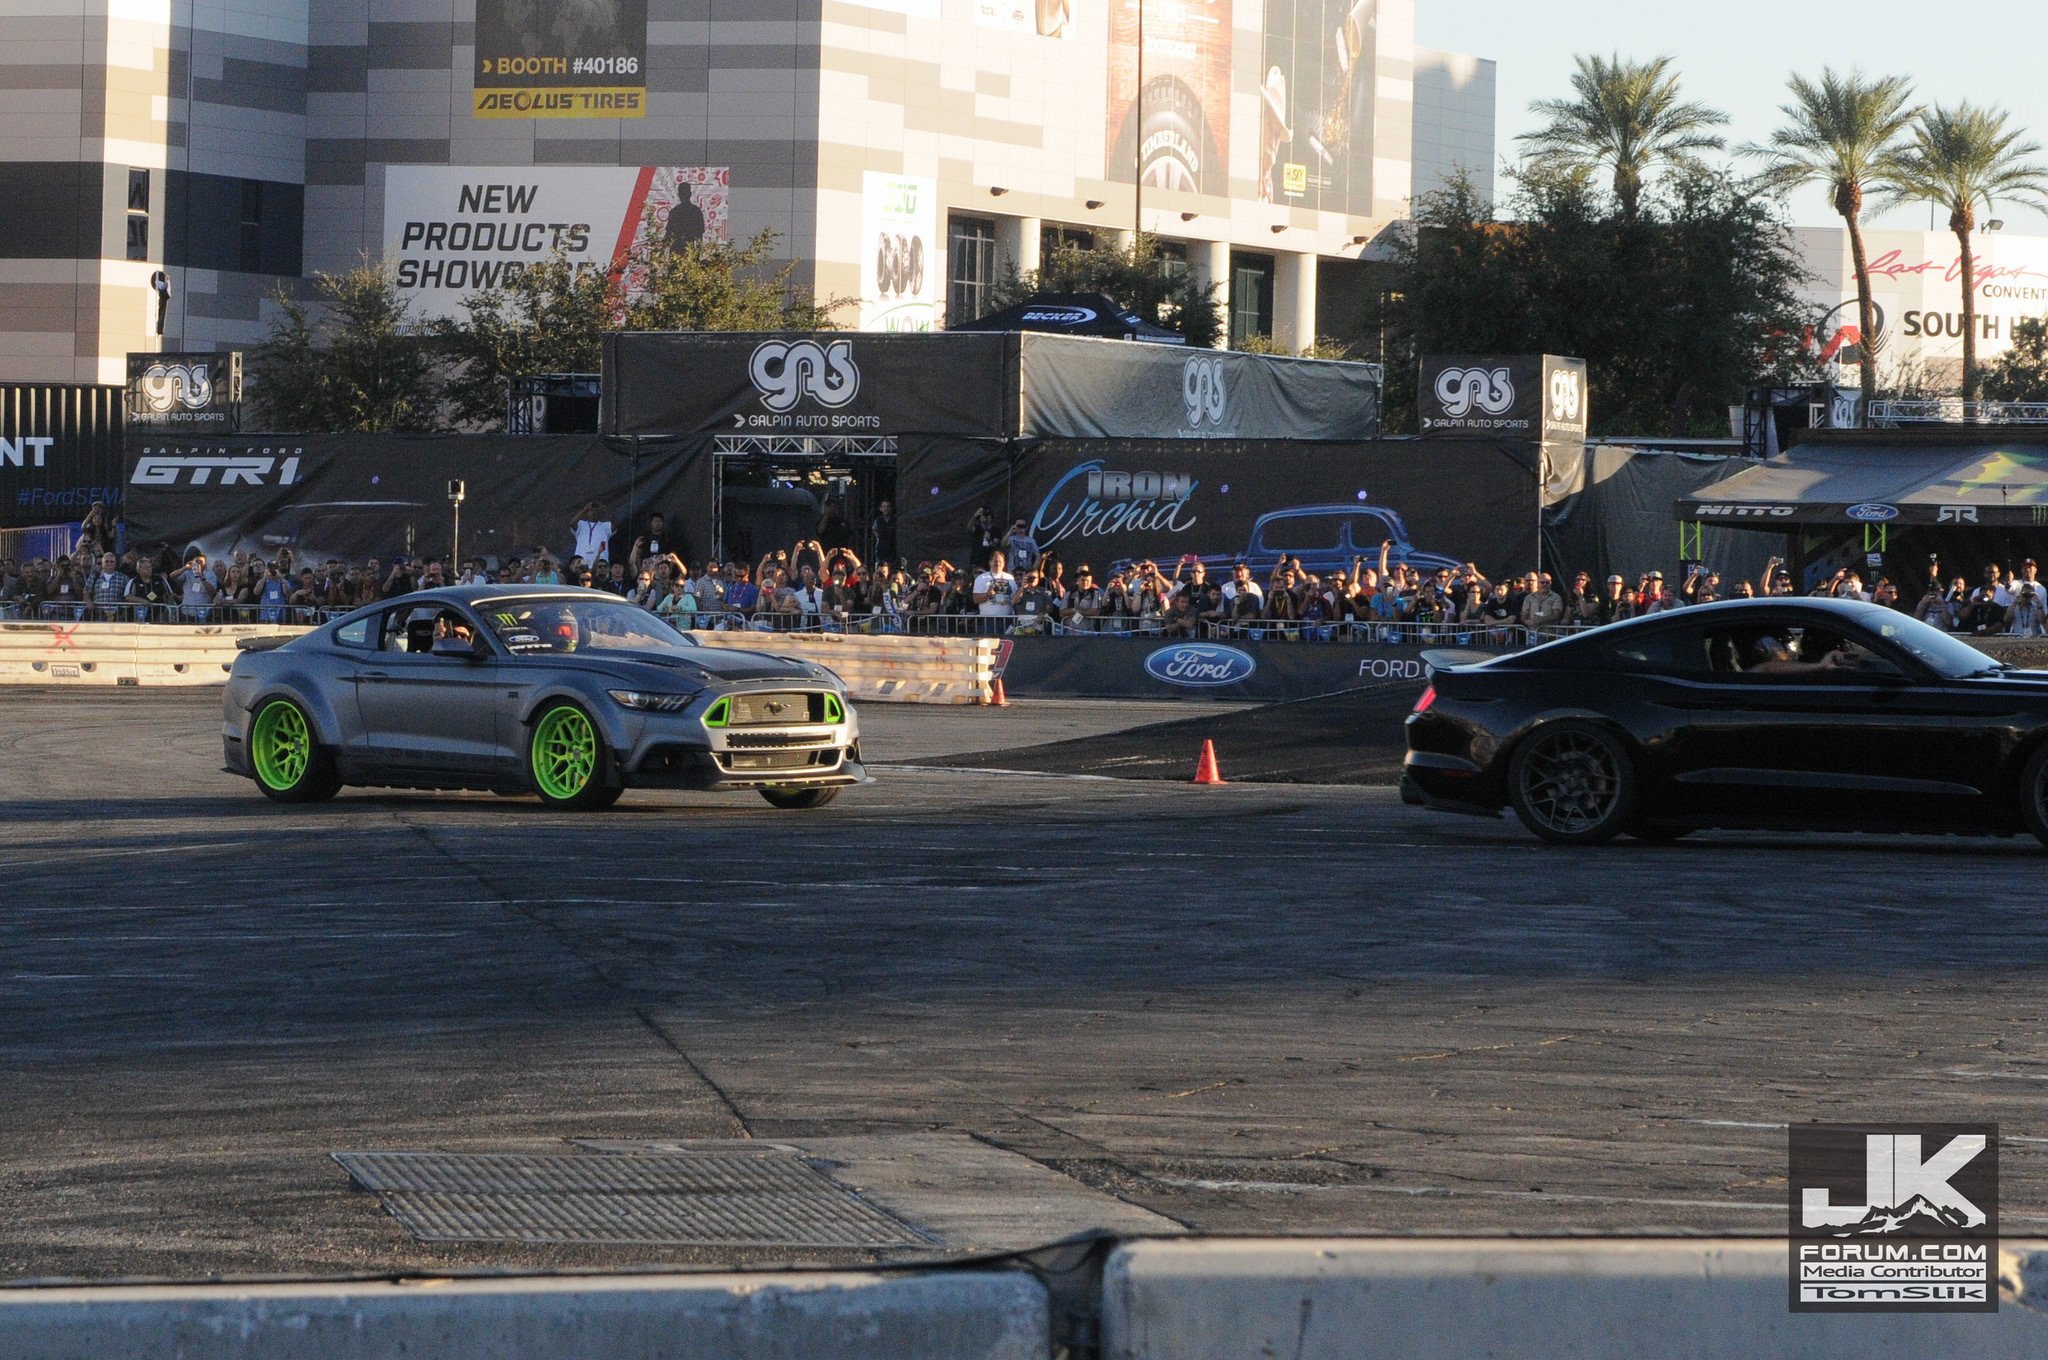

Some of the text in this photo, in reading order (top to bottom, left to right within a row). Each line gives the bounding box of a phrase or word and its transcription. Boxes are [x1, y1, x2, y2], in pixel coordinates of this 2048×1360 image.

[497, 57, 639, 75] BOOTH #40186
[477, 91, 641, 111] AEOLUS TIRES
[1141, 130, 1198, 172] TIMBERLAND
[457, 185, 538, 213] NEW
[402, 222, 590, 252] PRODUCTS
[1852, 249, 2048, 290] Las Vgas
[1982, 284, 2047, 300] CONVENT
[1021, 312, 1083, 321] BECKER
[141, 412, 225, 422] GALPIN AUTO SPORTS
[748, 414, 880, 427] GALPIN AUTO SPORTS
[1433, 418, 1529, 429] GALPIN AUTO SPORTS
[0, 436, 54, 467] NT
[130, 456, 299, 485] GTR1
[1087, 471, 1191, 501] IRON
[1029, 459, 1200, 550] Orchid
[1695, 505, 1794, 516] NITTO
[1937, 505, 1979, 523] RTR
[1358, 659, 1420, 678] FORD
